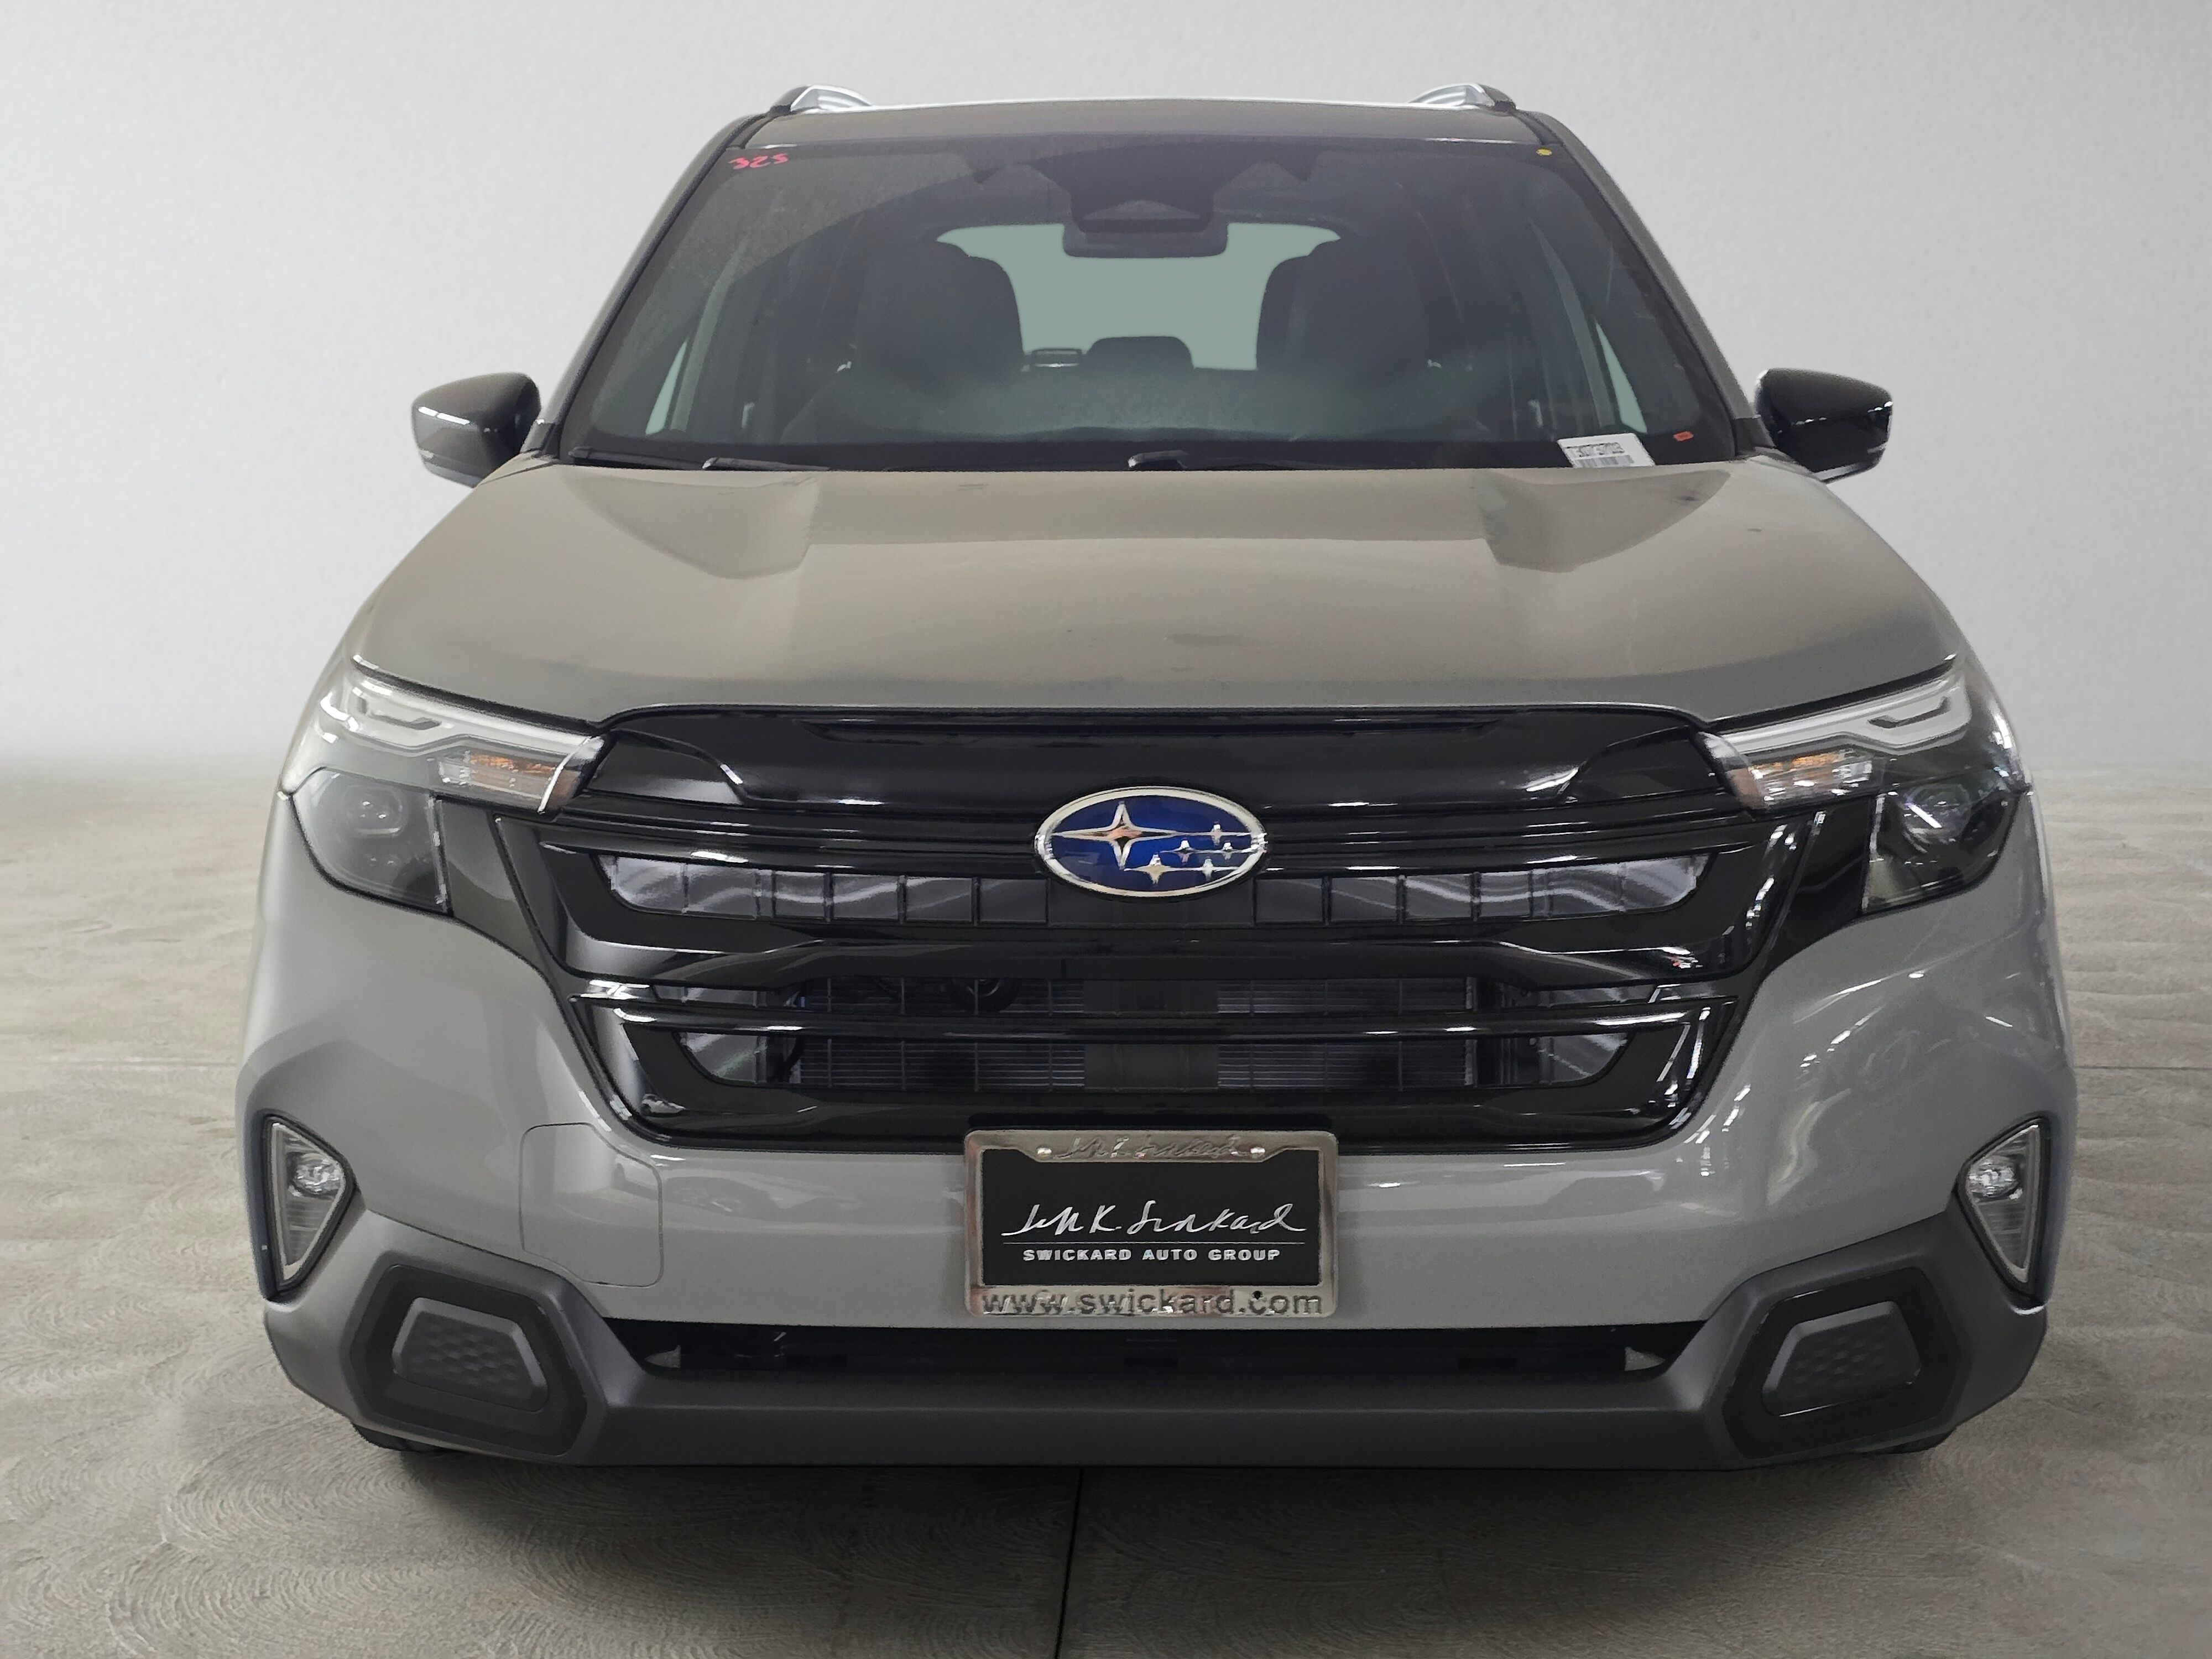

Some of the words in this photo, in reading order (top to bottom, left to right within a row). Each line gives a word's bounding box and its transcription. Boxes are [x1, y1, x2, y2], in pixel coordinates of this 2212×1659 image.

[1023, 1249, 1131, 1261] SWICKARD
[1142, 1249, 1197, 1261] AUTO
[1208, 1249, 1280, 1261] GROUP
[982, 1288, 1322, 1315] www.swickard.com
